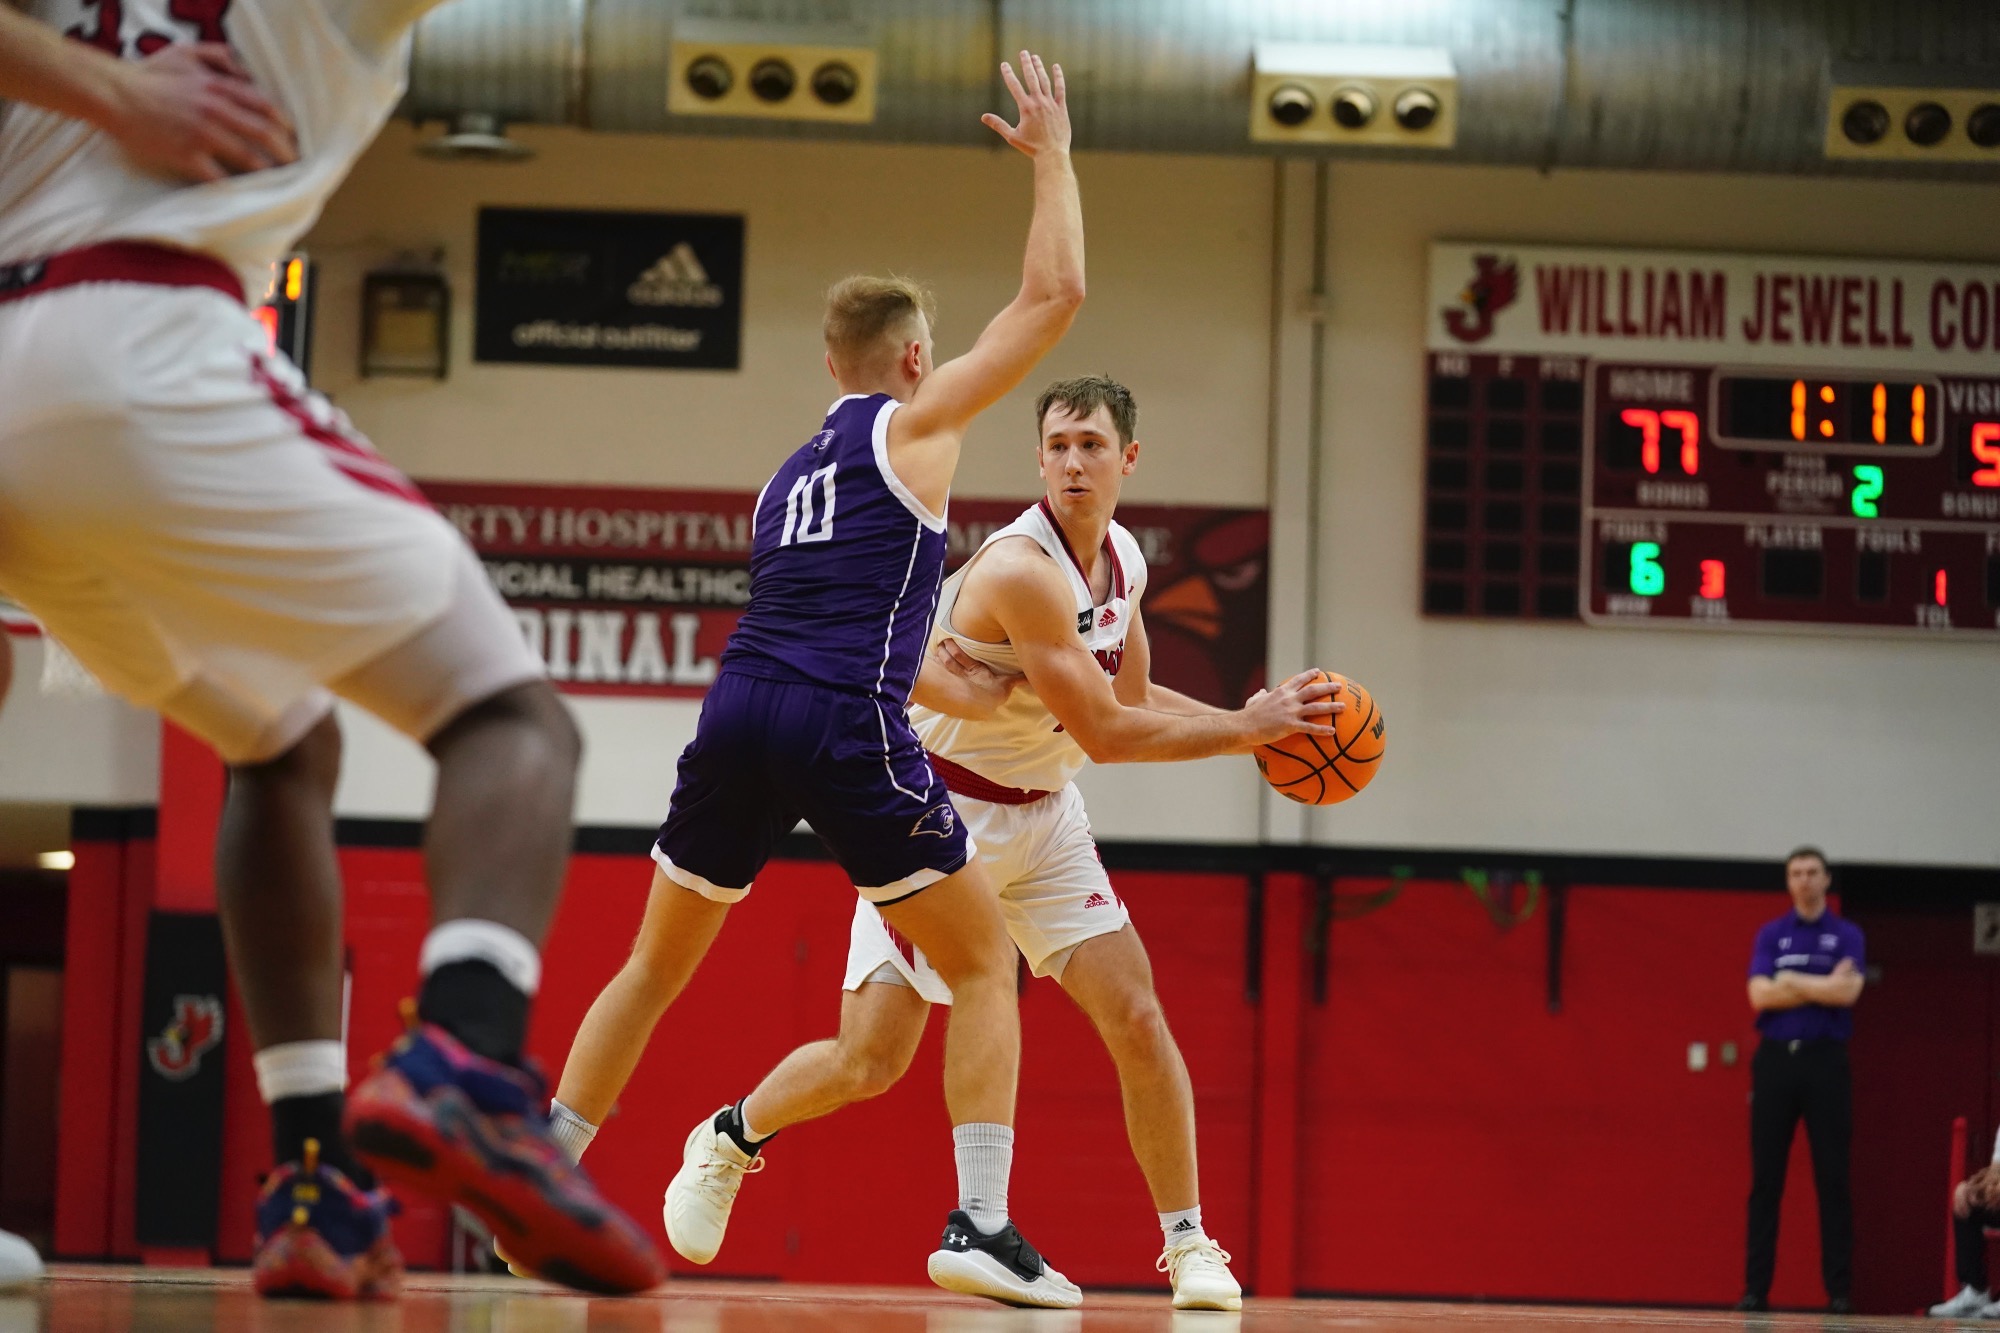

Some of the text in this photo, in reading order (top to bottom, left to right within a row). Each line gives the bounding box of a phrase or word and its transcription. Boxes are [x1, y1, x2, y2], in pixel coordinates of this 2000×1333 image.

[1535, 264, 2000, 353] WILLIAM JEWELL CO
[1609, 369, 1694, 401] HOME
[1620, 408, 1699, 476] 77
[1636, 480, 1709, 509] BONUS
[1765, 470, 1844, 499] PERIOD
[1851, 464, 1884, 519] 2
[779, 461, 838, 547] 10
[538, 507, 754, 552] HOSPITAL
[1744, 524, 1824, 550] PLAYER
[1855, 527, 1922, 555] FOULS
[1630, 541, 1665, 596] 6
[1700, 559, 1726, 599] 3
[1935, 569, 1947, 606] 1
[1084, 900, 1109, 909] adidas
